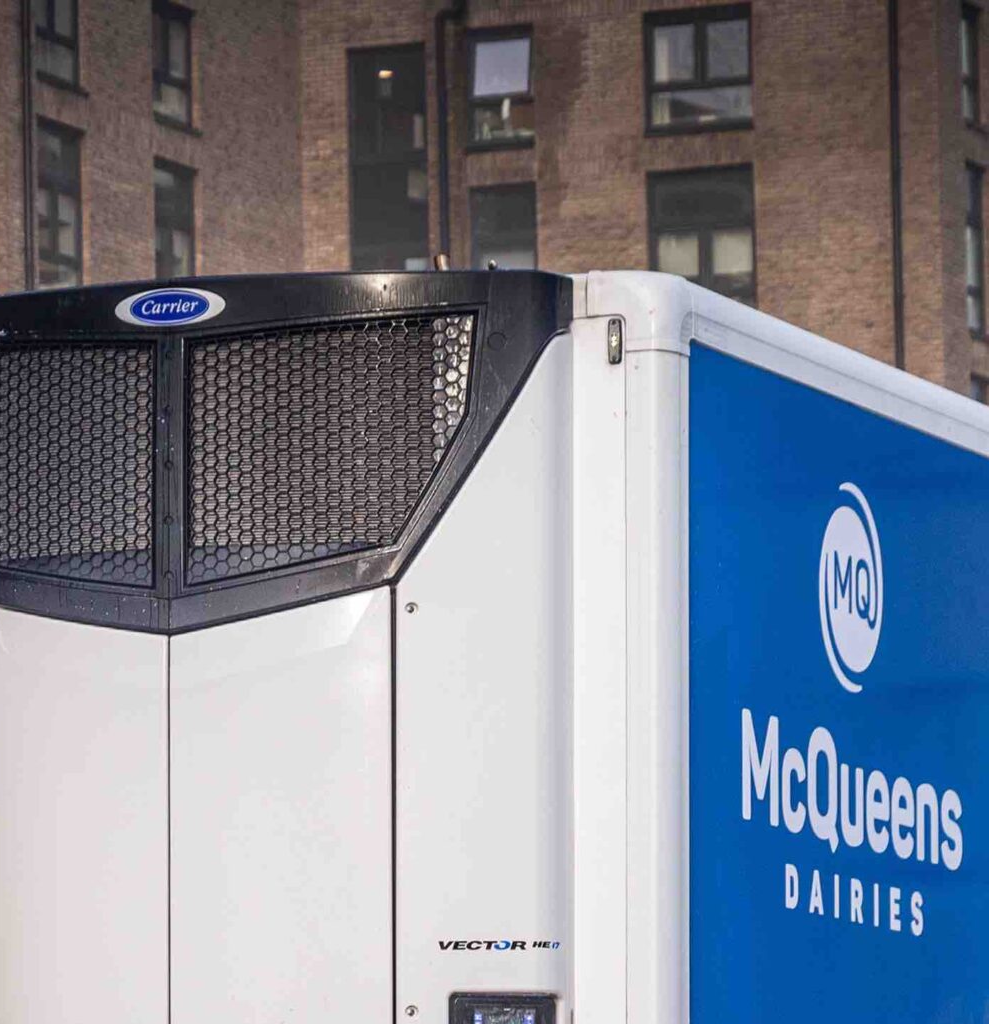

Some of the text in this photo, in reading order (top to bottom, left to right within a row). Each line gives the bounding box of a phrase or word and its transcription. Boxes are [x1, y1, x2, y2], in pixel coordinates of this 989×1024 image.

[141, 299, 199, 315] Carrier
[834, 550, 877, 630] MQ
[741, 708, 963, 871] McQueens
[784, 863, 924, 937] DAIRIES
[438, 940, 527, 951] VECTOR
